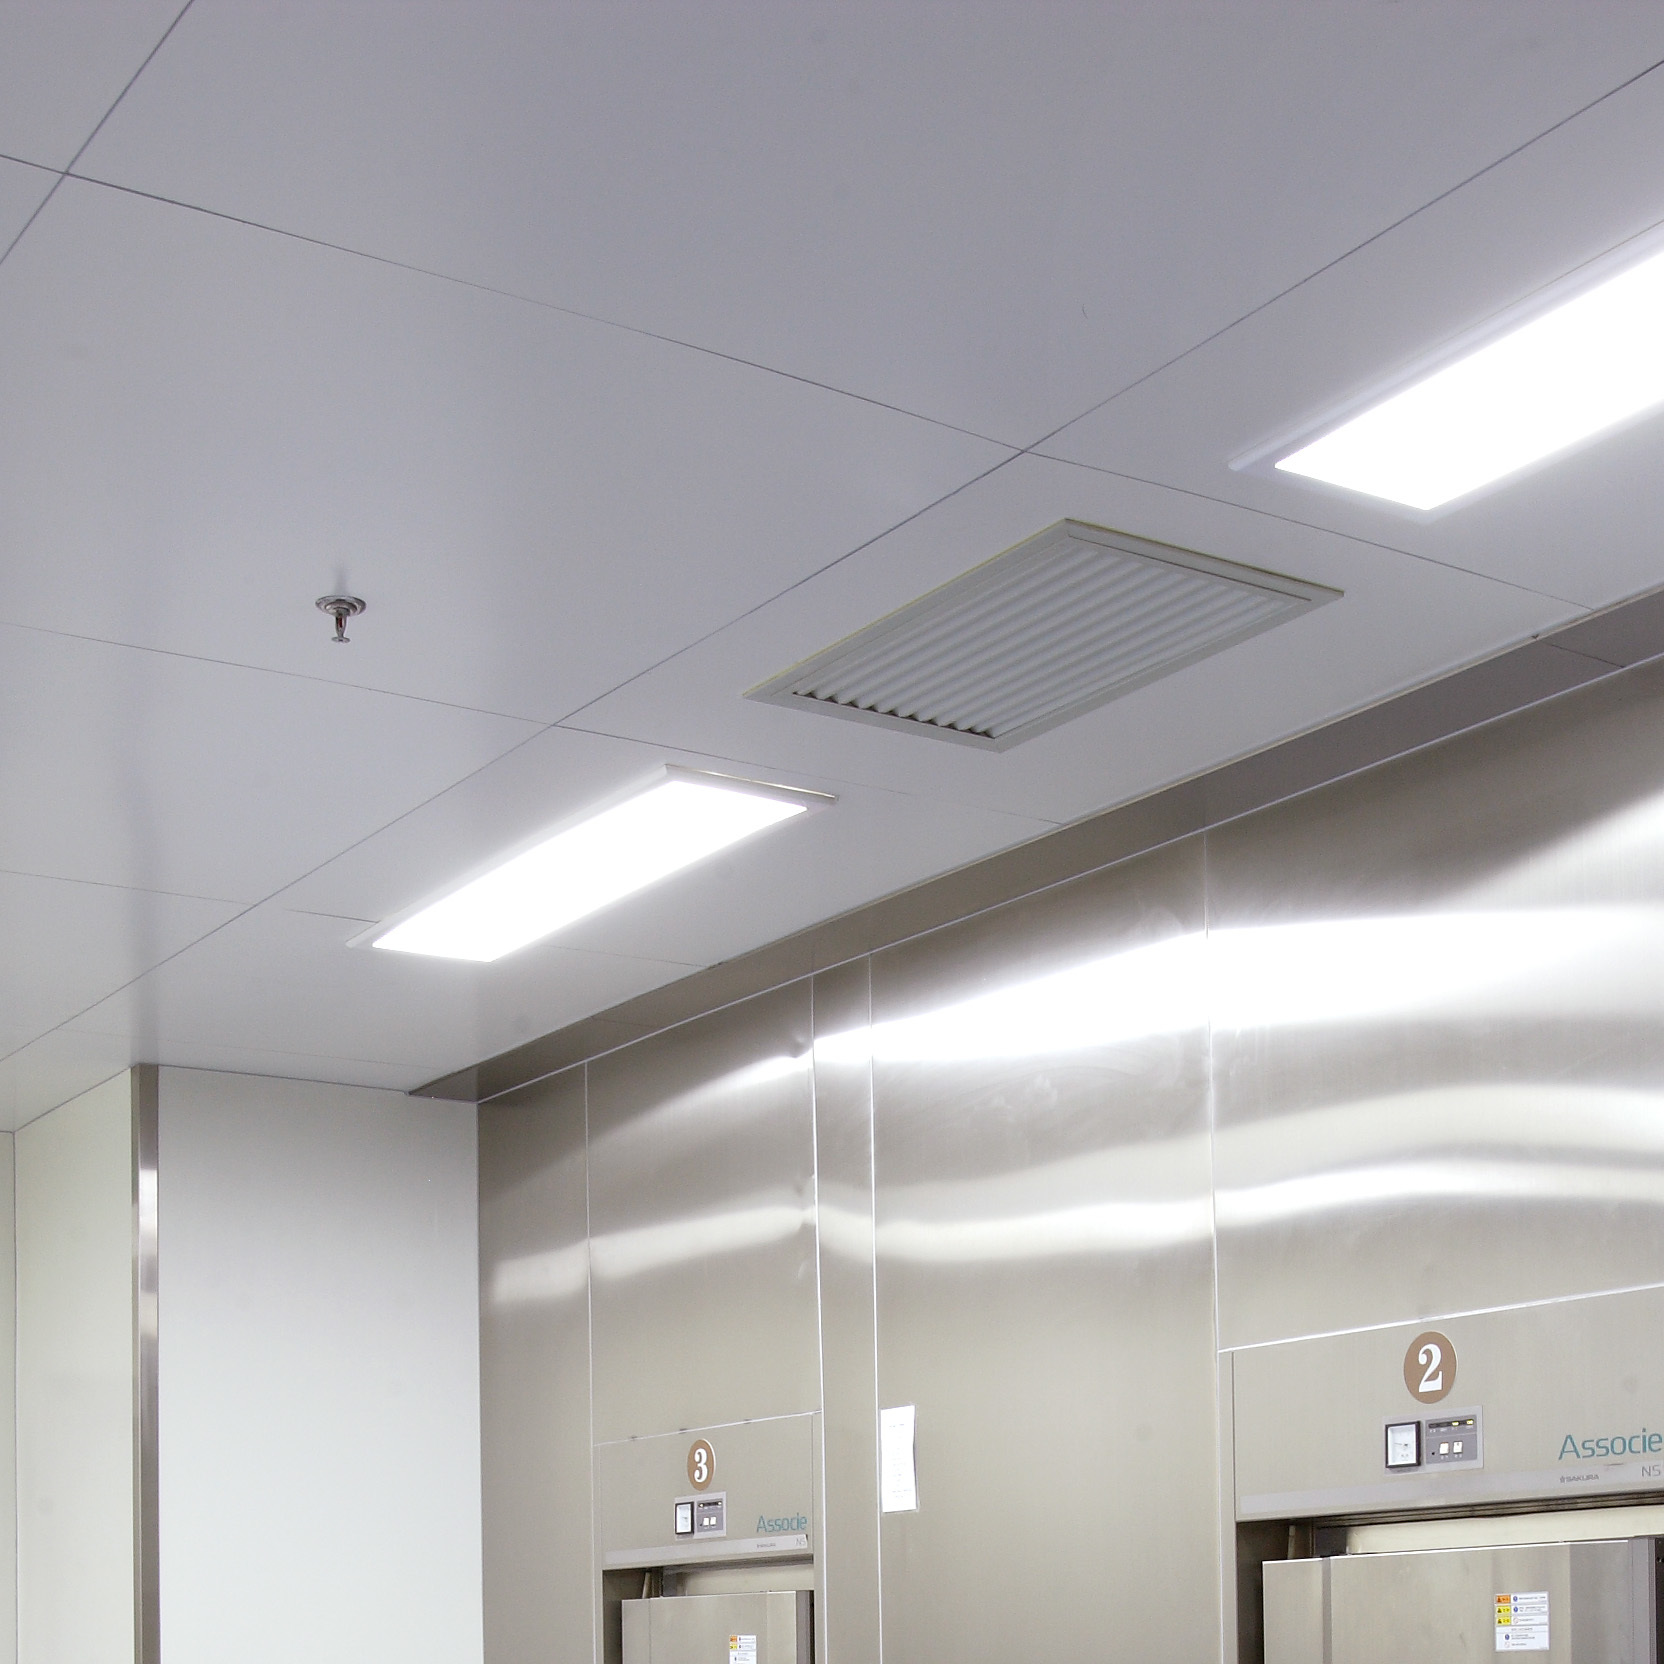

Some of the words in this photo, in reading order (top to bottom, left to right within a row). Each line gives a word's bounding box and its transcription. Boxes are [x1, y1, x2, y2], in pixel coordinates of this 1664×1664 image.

[1418, 1343, 1443, 1393] 2
[1558, 1427, 1663, 1460] Associe
[694, 1448, 708, 1483] 3
[756, 1512, 808, 1533] Associe
